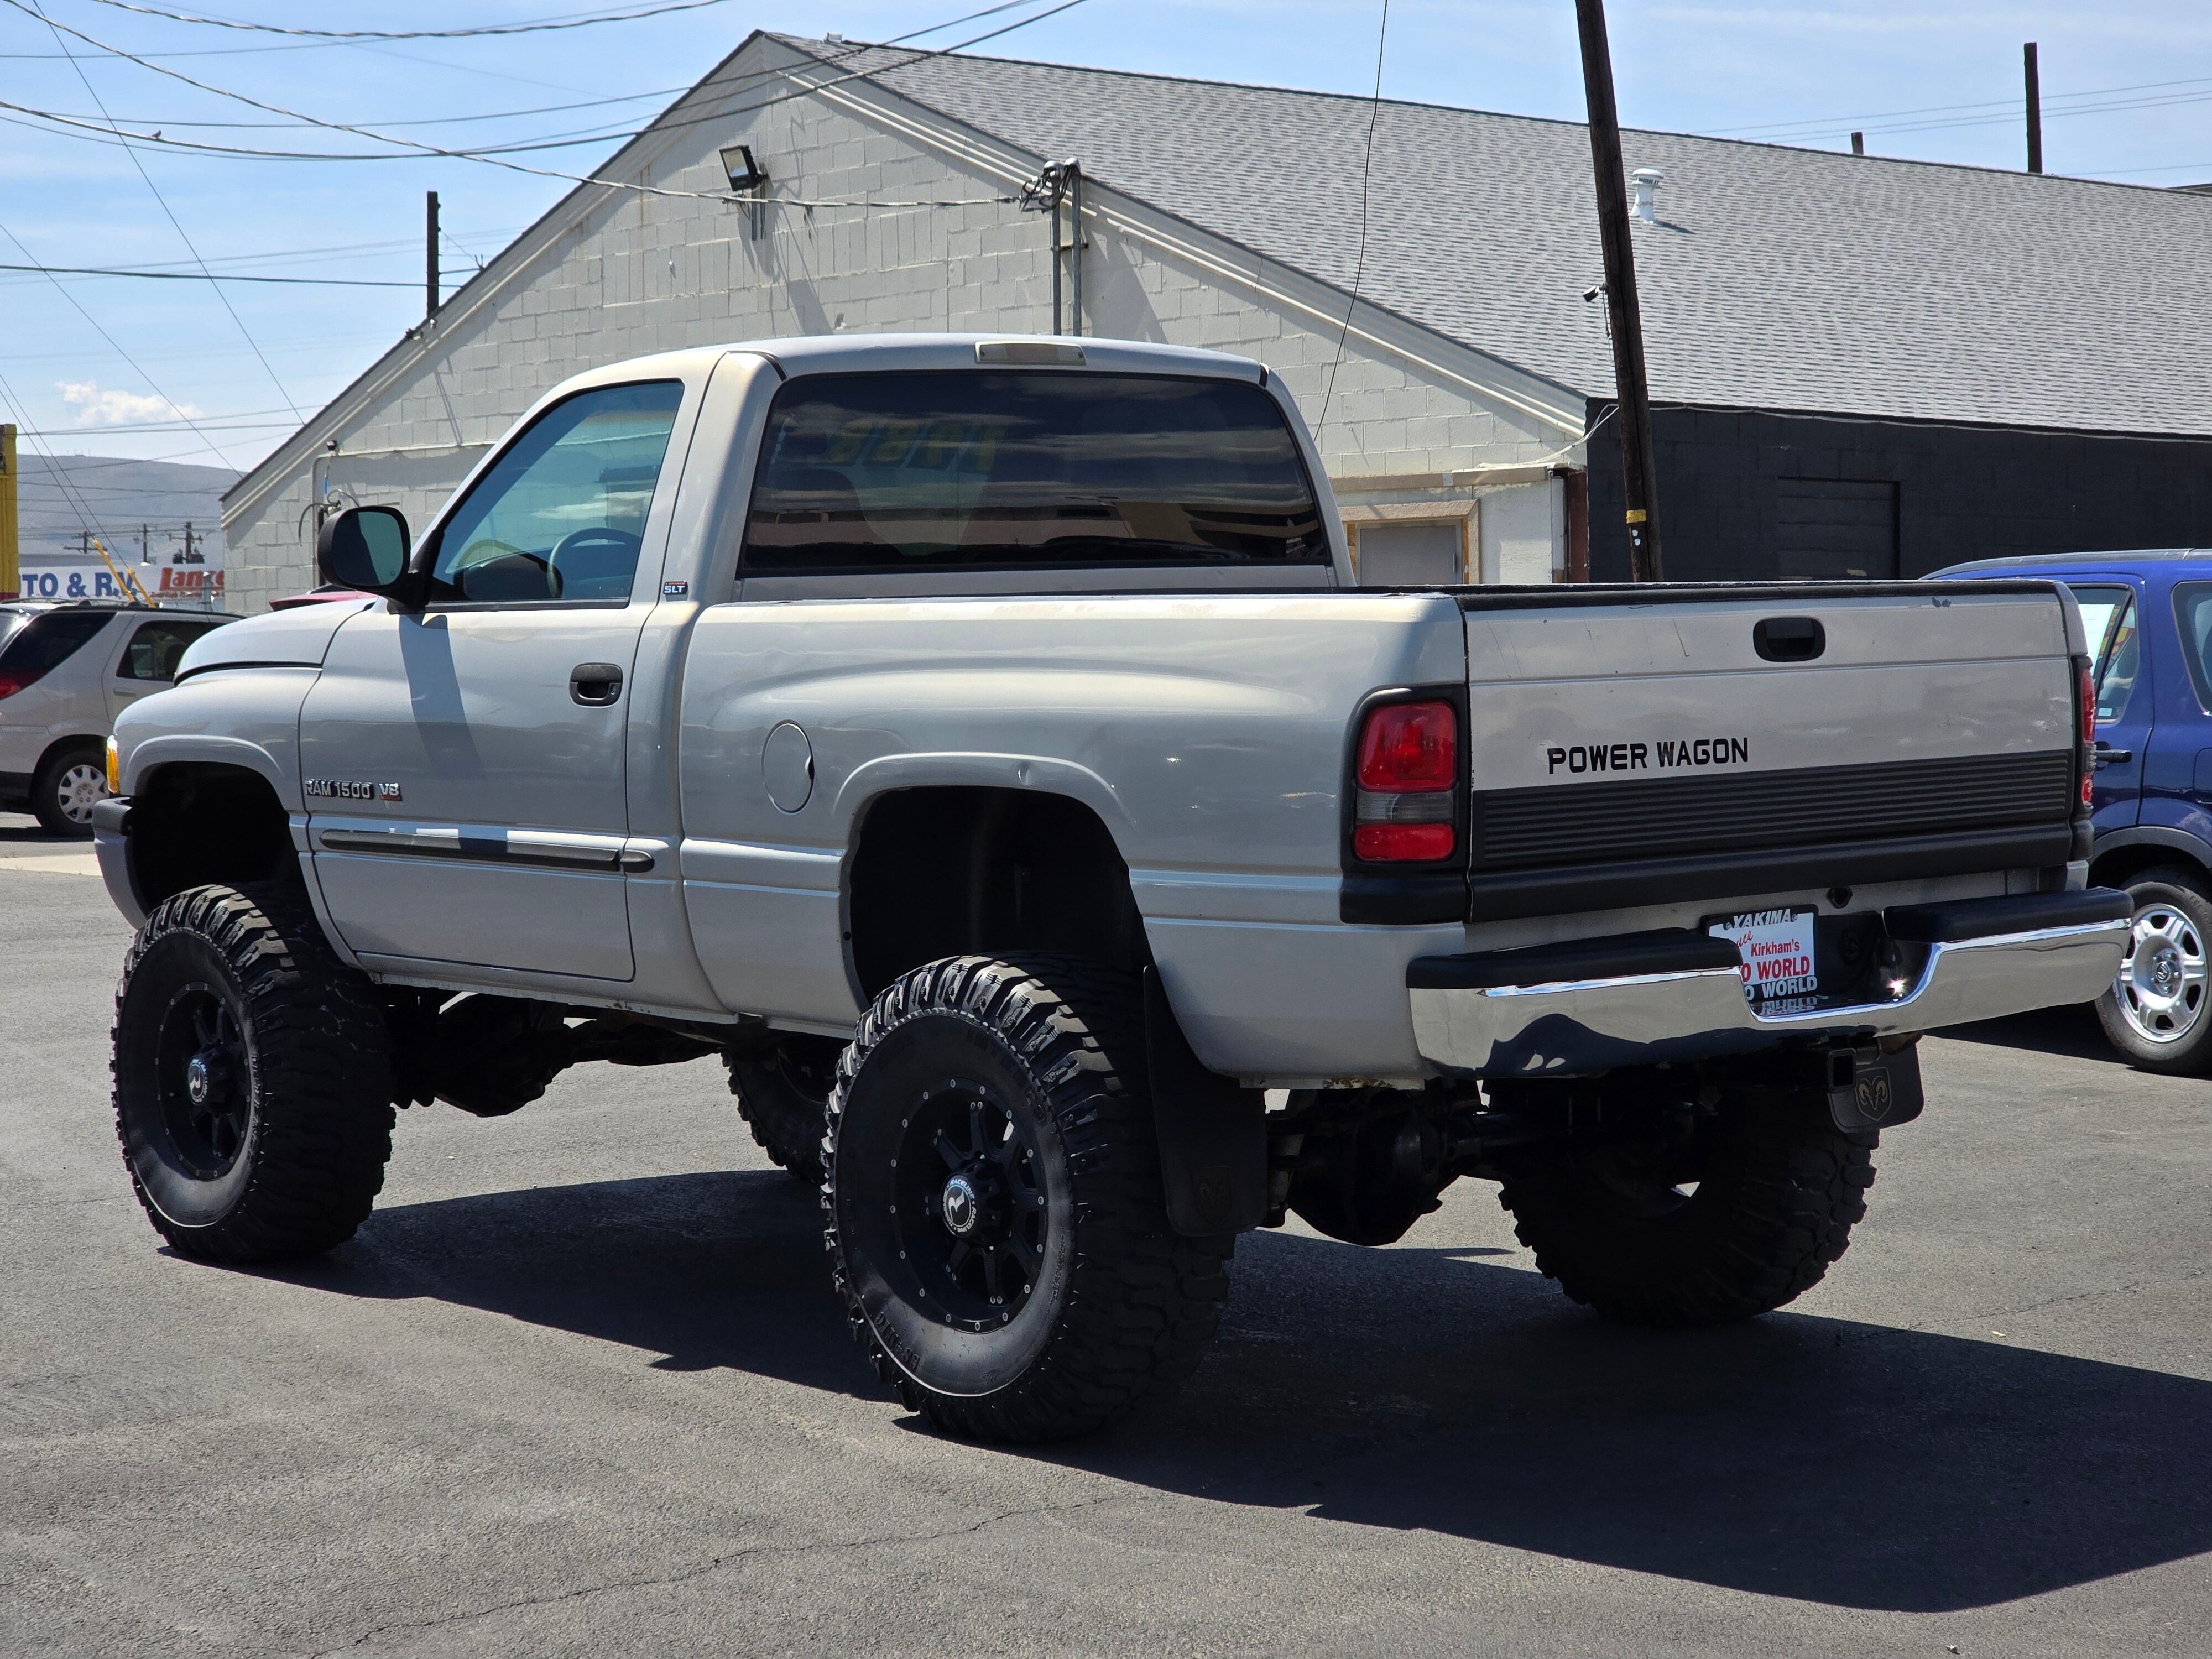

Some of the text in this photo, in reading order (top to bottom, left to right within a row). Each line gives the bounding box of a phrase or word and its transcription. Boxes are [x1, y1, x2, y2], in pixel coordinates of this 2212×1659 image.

[20, 573, 59, 597] TO
[67, 572, 88, 597] &
[1547, 737, 1749, 774] POWER WAGON
[304, 779, 400, 799] RAM 1500 V8
[1733, 909, 1791, 929] YAKIMA
[1751, 938, 1800, 957] Kirkham's
[1740, 956, 1810, 982] O WORLD
[1745, 976, 1818, 1001] O WORLD
[950, 1178, 975, 1199] RACELINE
